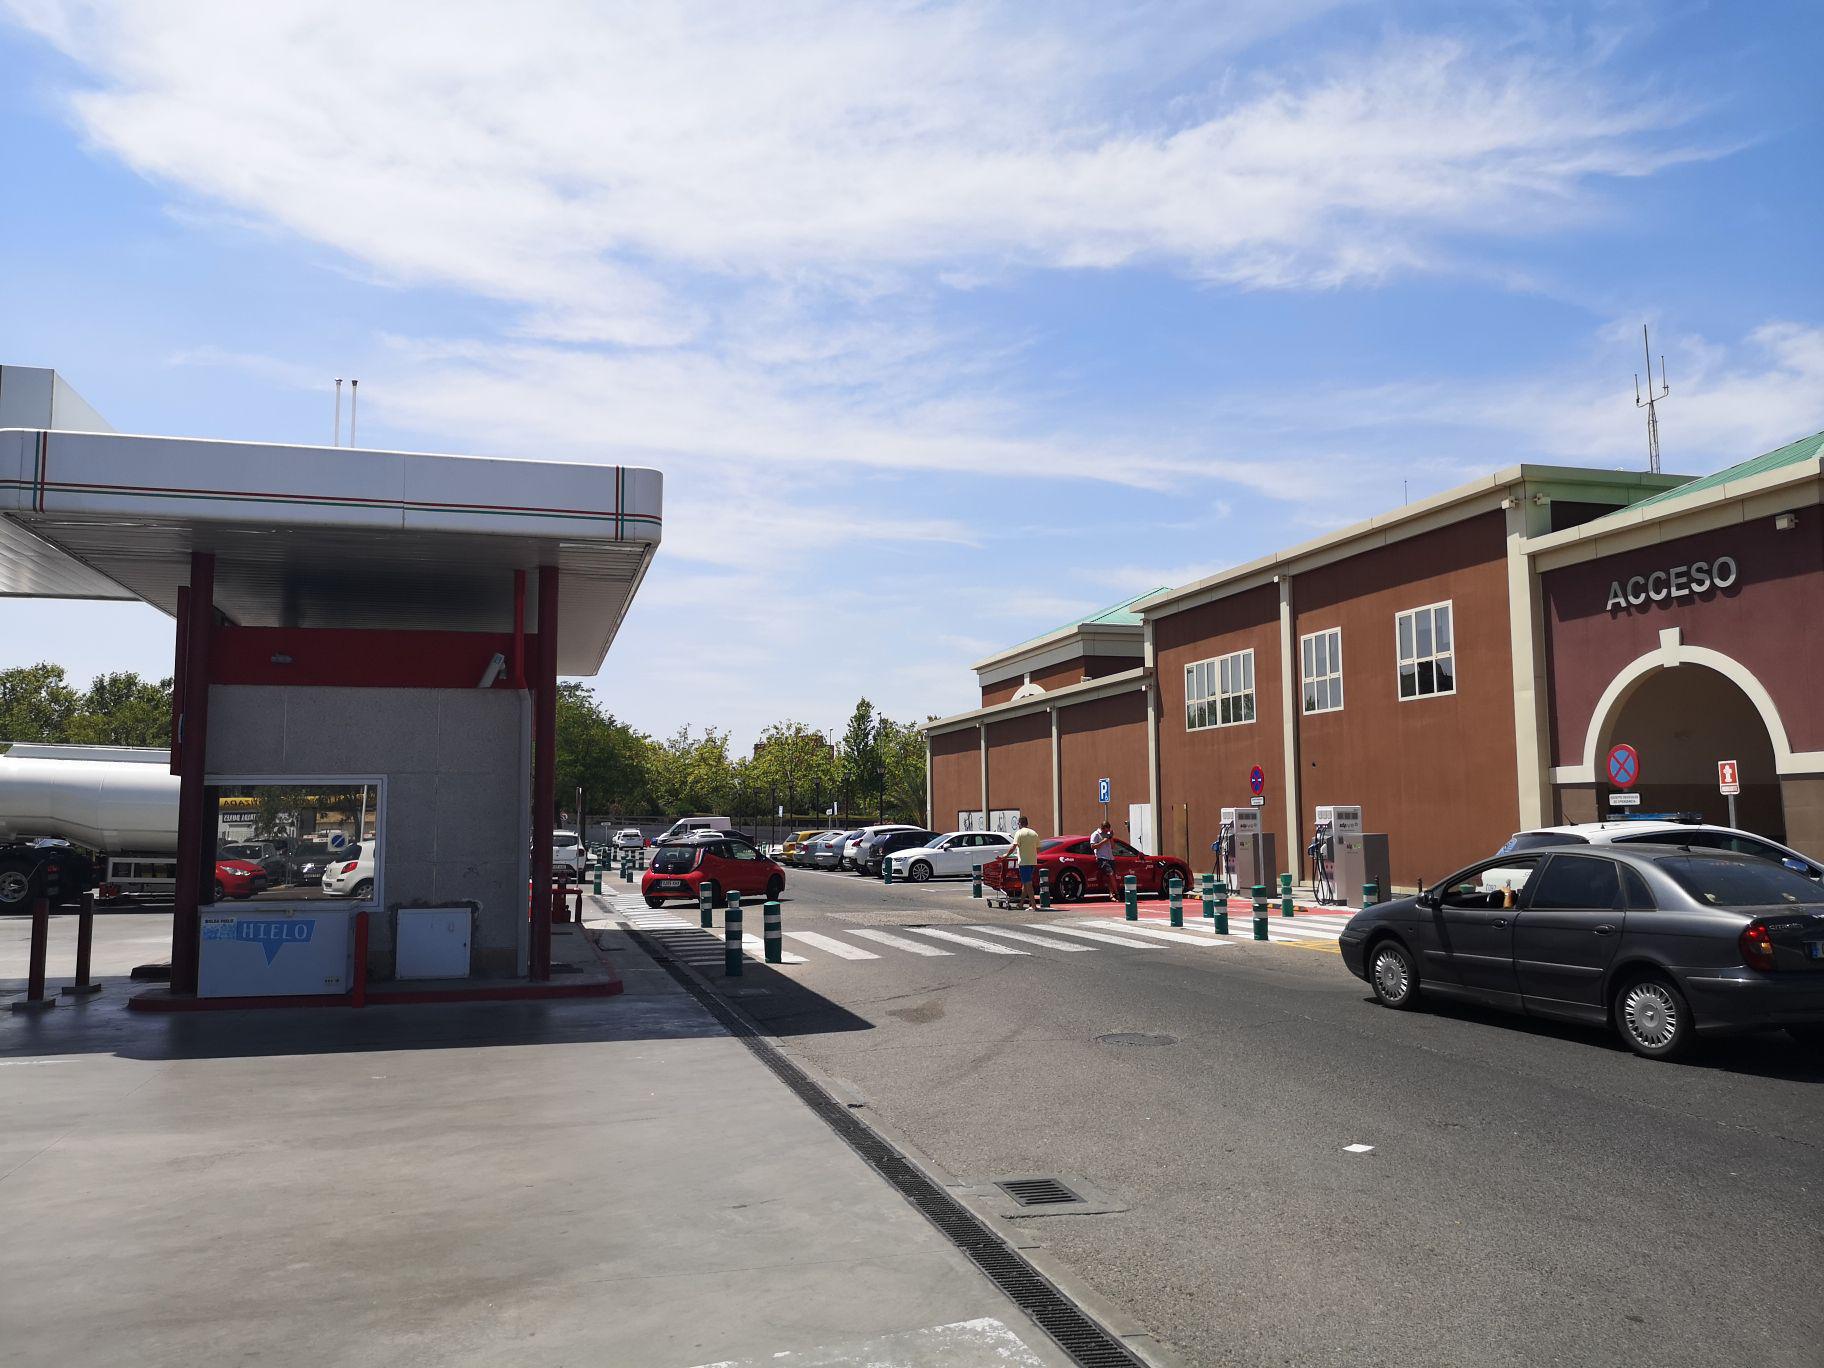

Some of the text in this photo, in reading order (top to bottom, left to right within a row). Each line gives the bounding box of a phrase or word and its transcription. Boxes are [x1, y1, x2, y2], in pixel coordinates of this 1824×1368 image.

[1606, 556, 1738, 612] ACCESO
[1101, 781, 1108, 799] P
[242, 923, 308, 939] HIELO
